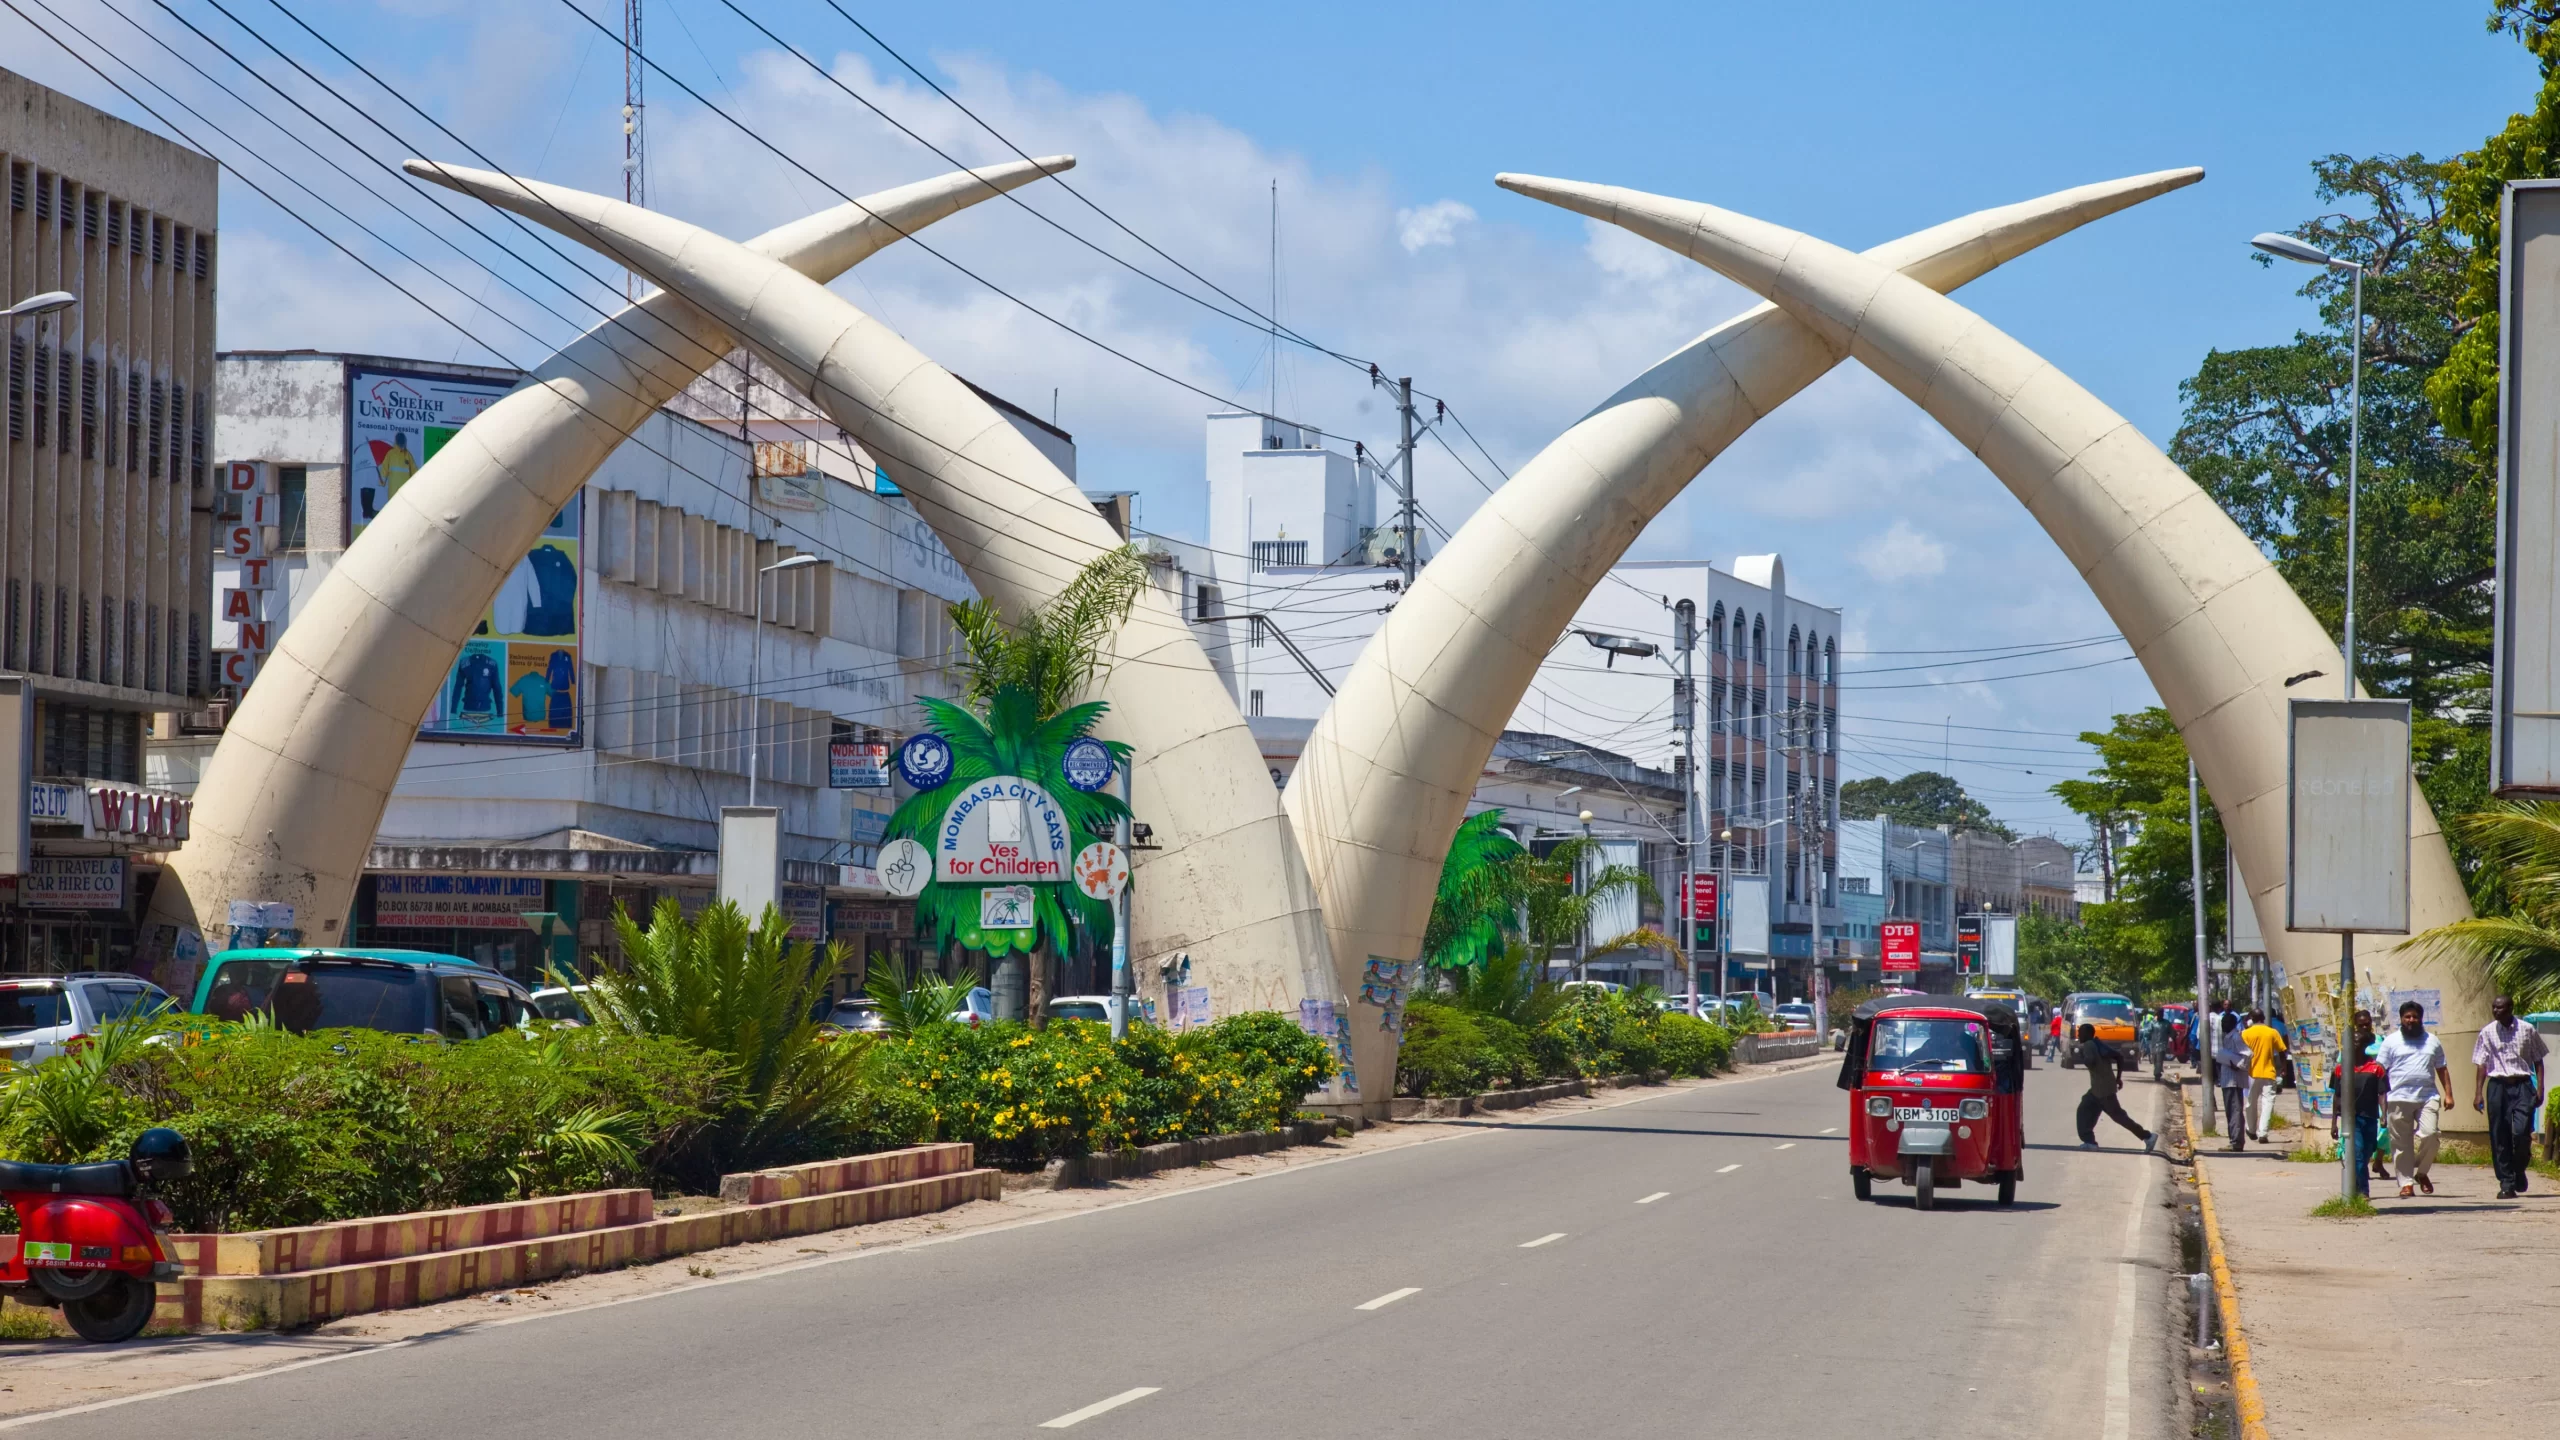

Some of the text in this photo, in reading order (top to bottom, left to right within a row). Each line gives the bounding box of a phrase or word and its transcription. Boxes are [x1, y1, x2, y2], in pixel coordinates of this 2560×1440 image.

[389, 391, 444, 412] SHEIKH
[359, 400, 435, 423] UNIFORMS
[357, 422, 419, 434] Seasonal Dressing
[226, 463, 268, 702] DISTANC
[831, 758, 888, 767] FREIGHT LT
[908, 774, 944, 785] unicef
[31, 786, 67, 816] ES LTD
[99, 788, 193, 841] WIMPY
[944, 784, 1065, 851] MOMBASA CITY SAYS
[989, 844, 1019, 857] Yes
[32, 858, 120, 875] RIT TRAVEL &
[950, 857, 1059, 874] for Children
[27, 876, 54, 891] CAR
[58, 877, 91, 891] HIRE
[94, 877, 115, 891] CO.
[377, 875, 542, 896] CGM TREADING COMPANY LIMITED
[410, 901, 432, 912] 86738
[435, 902, 451, 912] MOI
[453, 902, 470, 912] AVE.
[472, 902, 511, 913] MOMBASA
[377, 914, 407, 924] IMPORTERS
[414, 915, 447, 925] EXPORTERS
[448, 915, 455, 925] OF
[456, 915, 468, 925] NEW
[475, 916, 490, 926] USED
[491, 916, 518, 927] JAPANESE
[837, 910, 892, 920] RAFFIQ'S
[1885, 925, 1914, 936] DTB
[1895, 1108, 1959, 1121] KBM 310B
